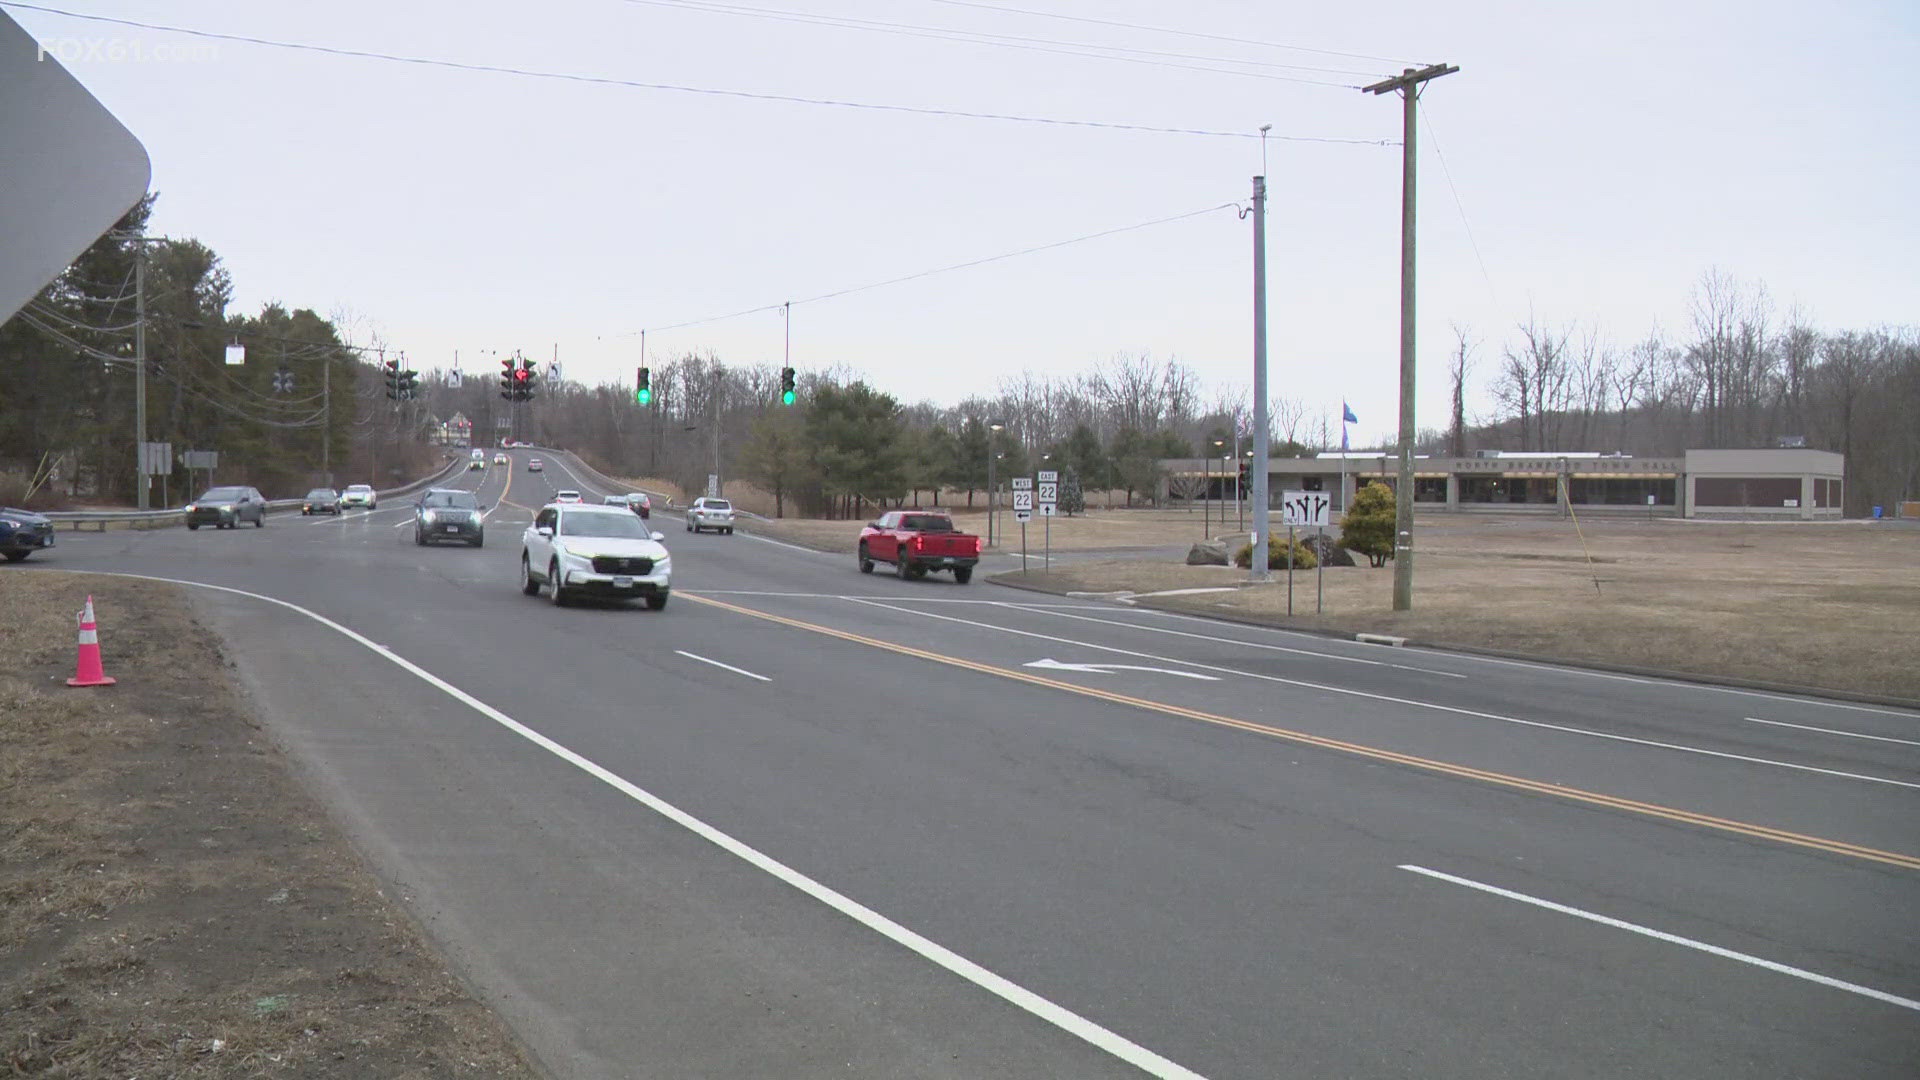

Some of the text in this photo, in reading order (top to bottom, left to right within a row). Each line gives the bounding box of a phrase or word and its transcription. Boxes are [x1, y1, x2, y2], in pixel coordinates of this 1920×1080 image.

[1456, 462, 1499, 470] NORTH
[1592, 461, 1631, 470] TOWN
[1641, 461, 1677, 470] HALL
[1041, 486, 1055, 498] 22
[1015, 494, 1030, 506] 22
